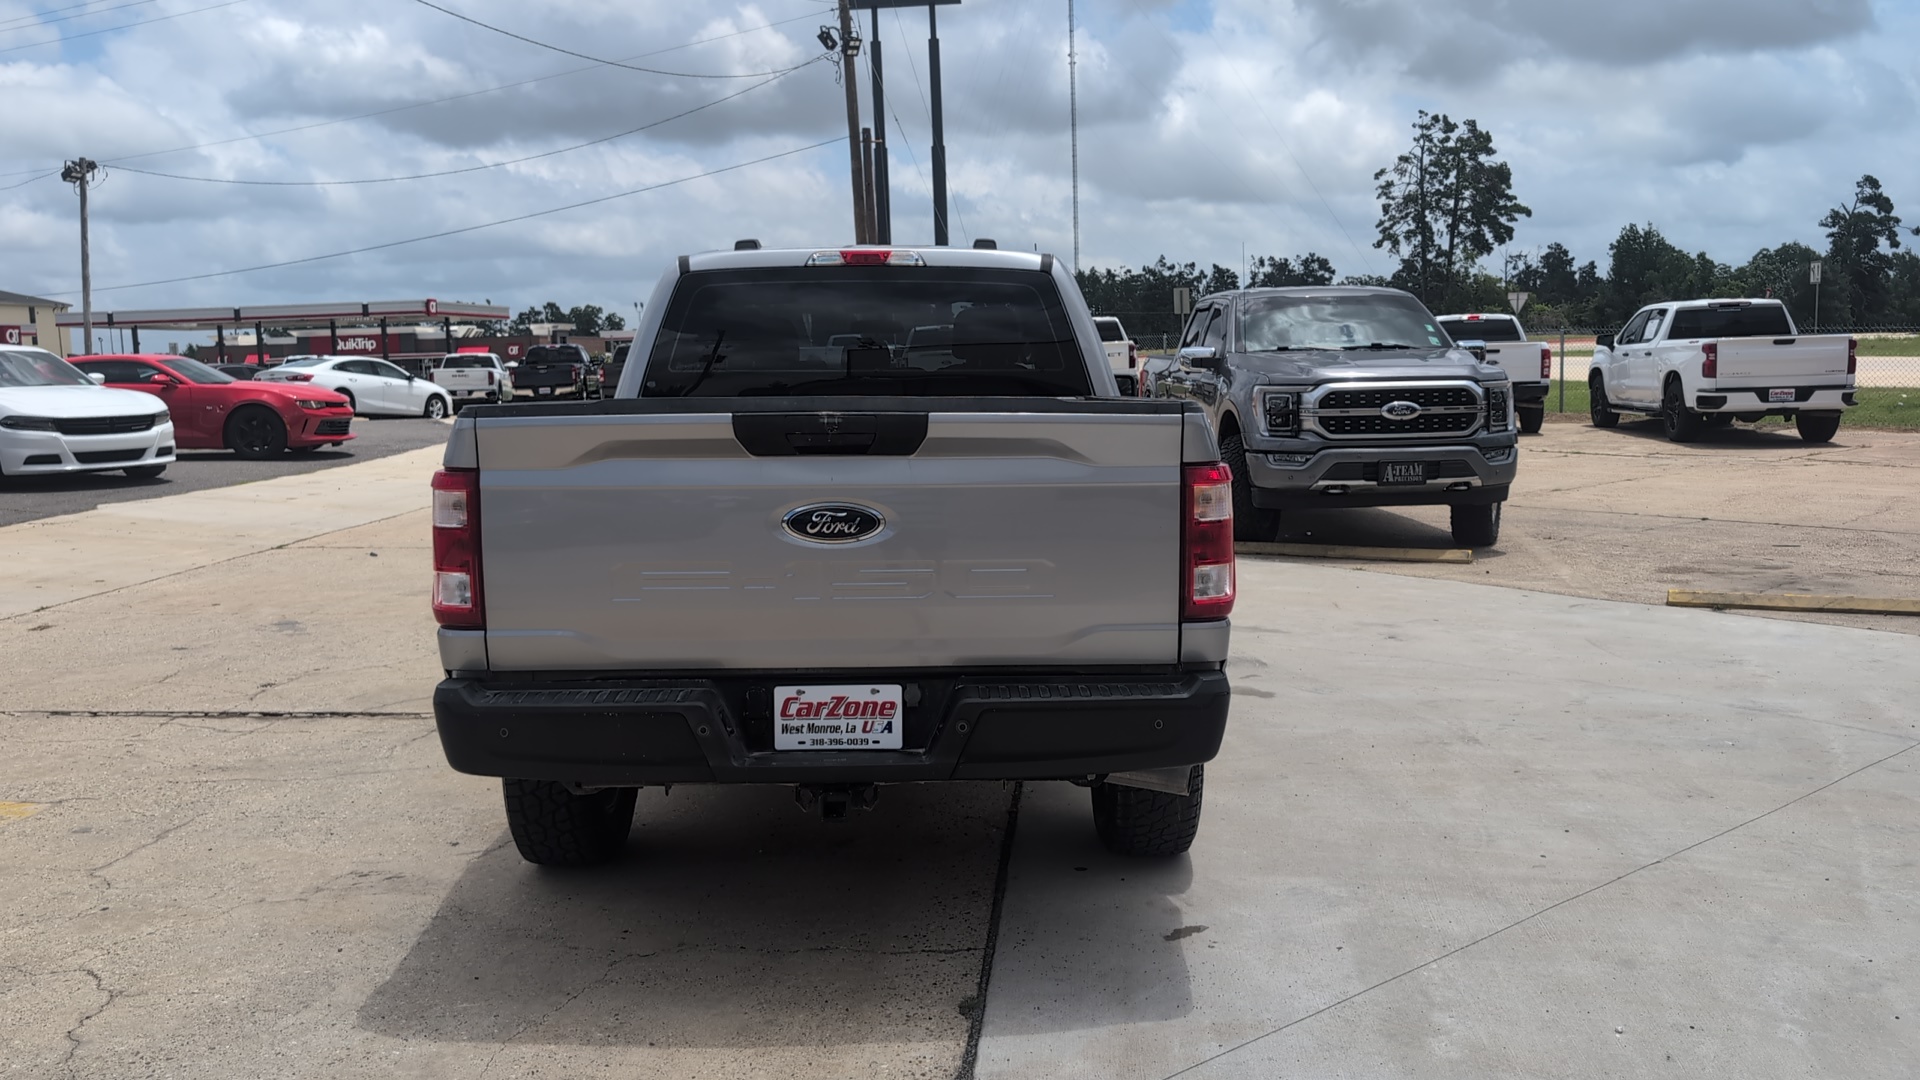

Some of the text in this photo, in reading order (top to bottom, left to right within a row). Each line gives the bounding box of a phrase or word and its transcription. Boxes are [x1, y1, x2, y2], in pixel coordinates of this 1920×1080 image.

[6, 329, 19, 344] QT
[508, 344, 520, 355] QT
[806, 511, 861, 534] Ford
[780, 695, 898, 721] CarZone
[781, 722, 857, 736] West Monroe, La
[861, 720, 893, 734] USA
[809, 738, 869, 747] 318-396-0039
